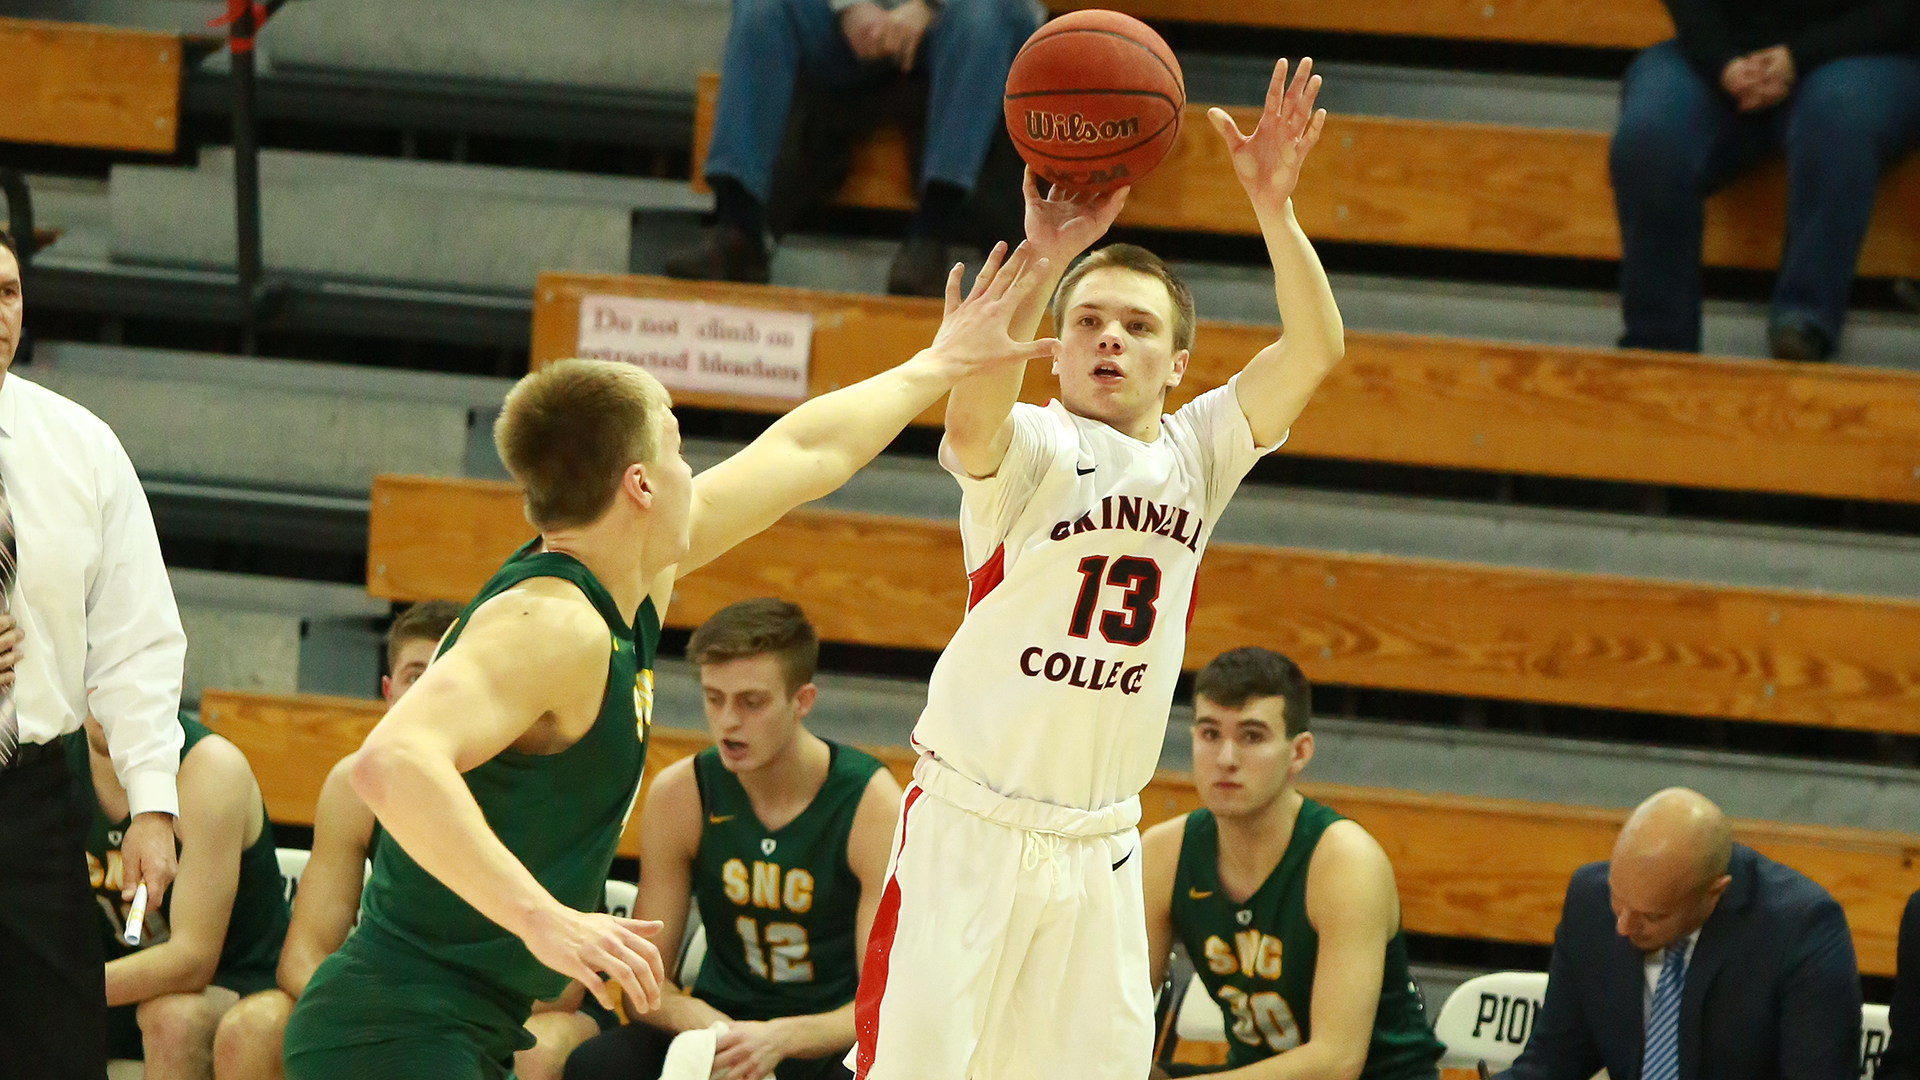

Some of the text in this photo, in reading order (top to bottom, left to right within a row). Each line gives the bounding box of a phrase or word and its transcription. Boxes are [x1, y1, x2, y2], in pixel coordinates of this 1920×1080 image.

[1024, 109, 1139, 144] Wilson
[594, 307, 632, 333] Do
[638, 318, 679, 334] not
[1068, 555, 1162, 646] 13
[85, 850, 123, 891] SN
[722, 858, 815, 913] SNC
[736, 915, 815, 983] 12
[1472, 993, 1541, 1044] PIO
